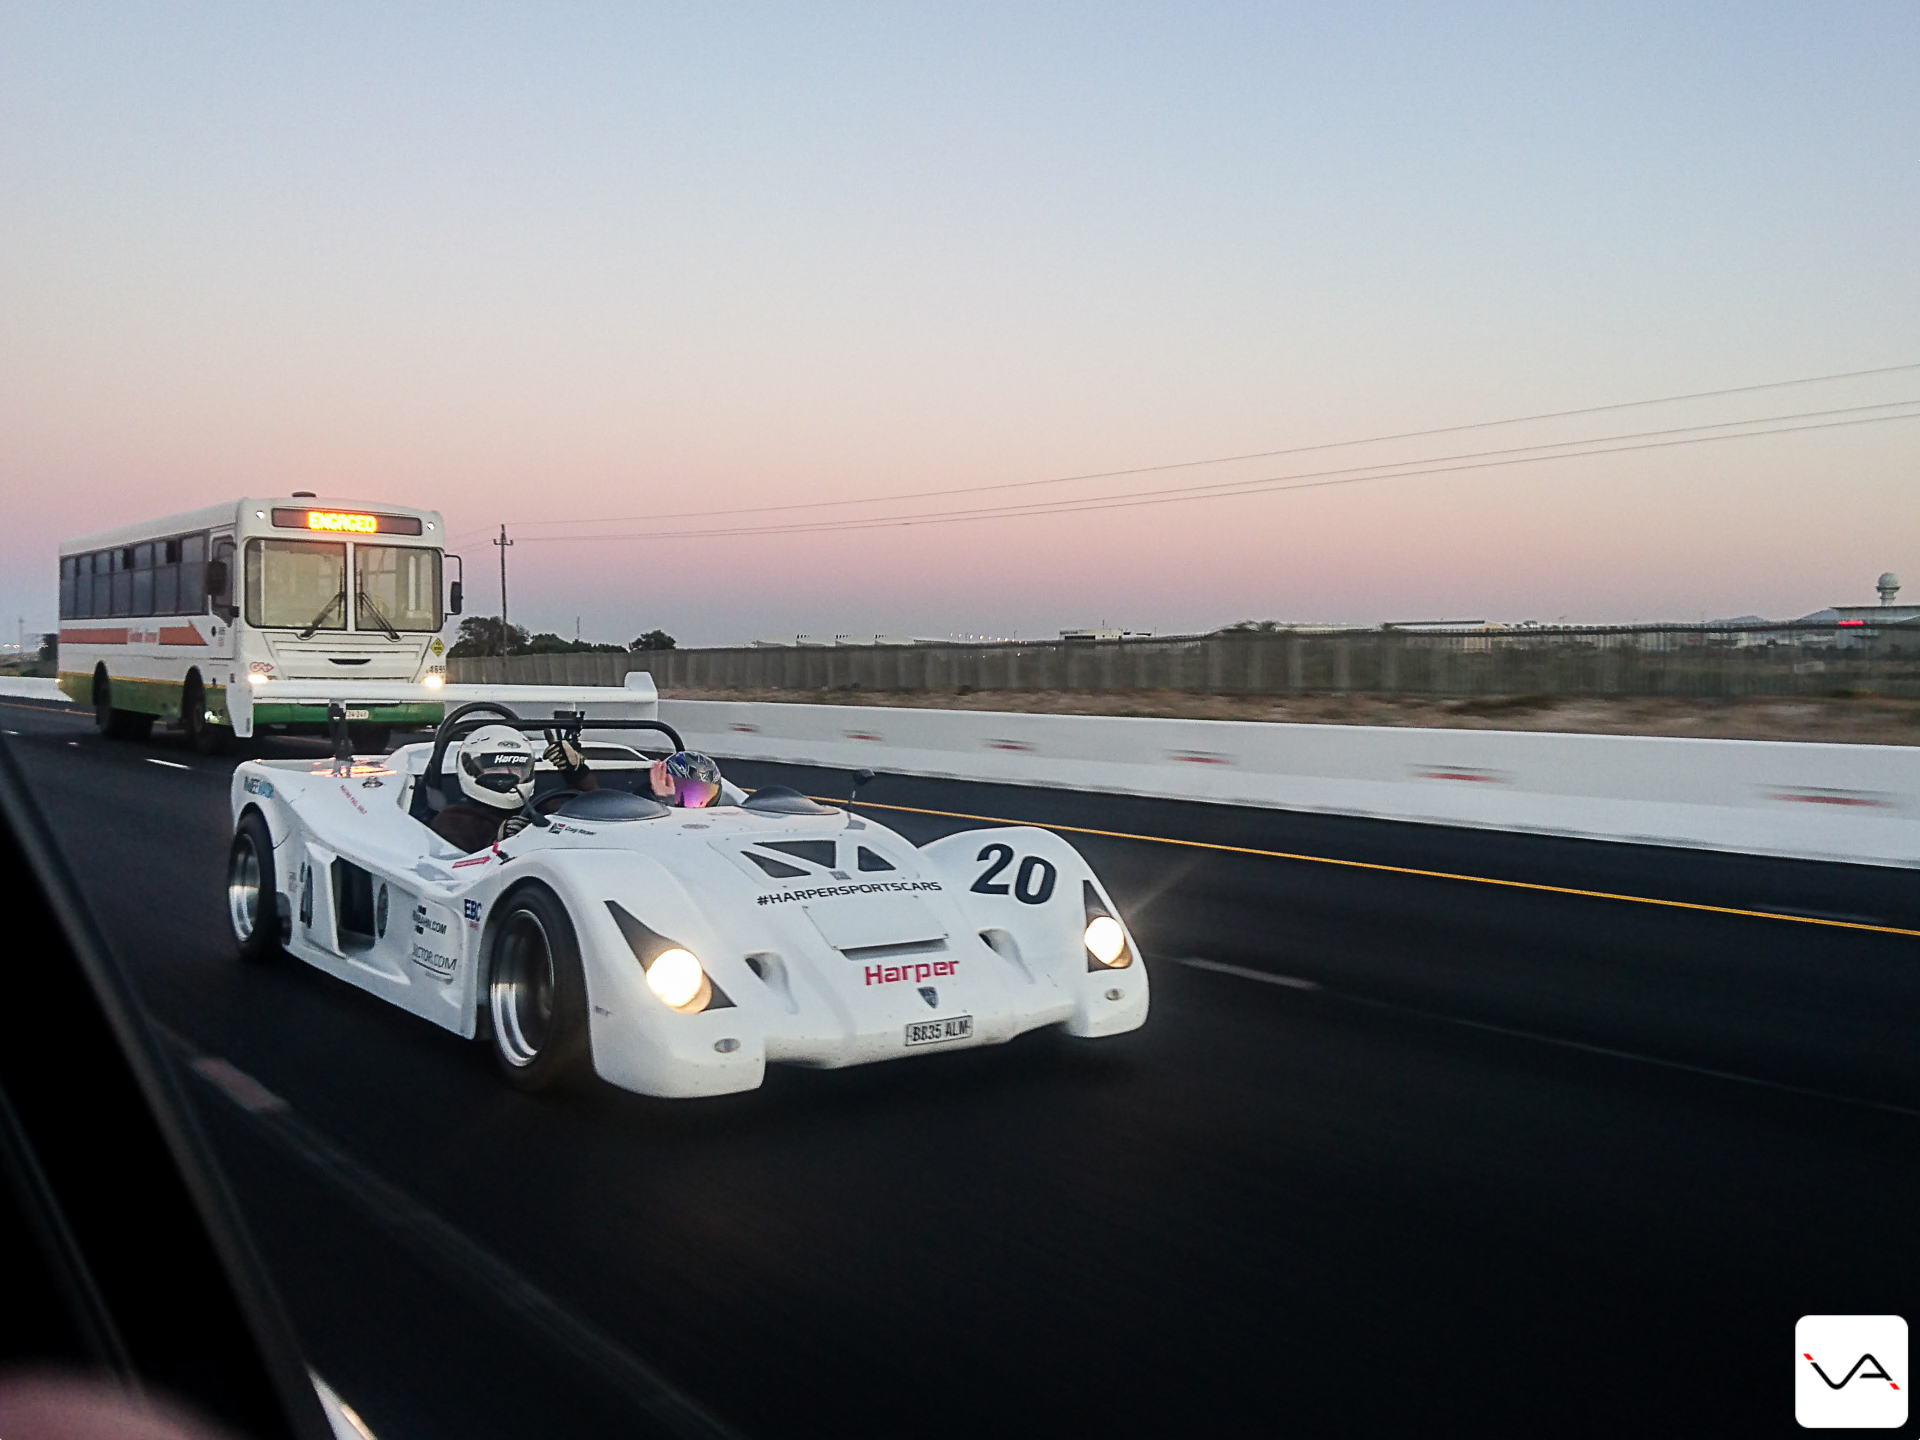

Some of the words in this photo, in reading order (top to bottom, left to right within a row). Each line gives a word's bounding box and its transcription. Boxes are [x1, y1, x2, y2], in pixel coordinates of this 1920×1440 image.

[307, 511, 378, 533] ENGAGED
[494, 754, 529, 764] Harper
[970, 843, 1057, 905] 20
[757, 880, 943, 906] #HARPERSPORTSCARS
[464, 898, 483, 923] EBC
[864, 960, 960, 986] Harper
